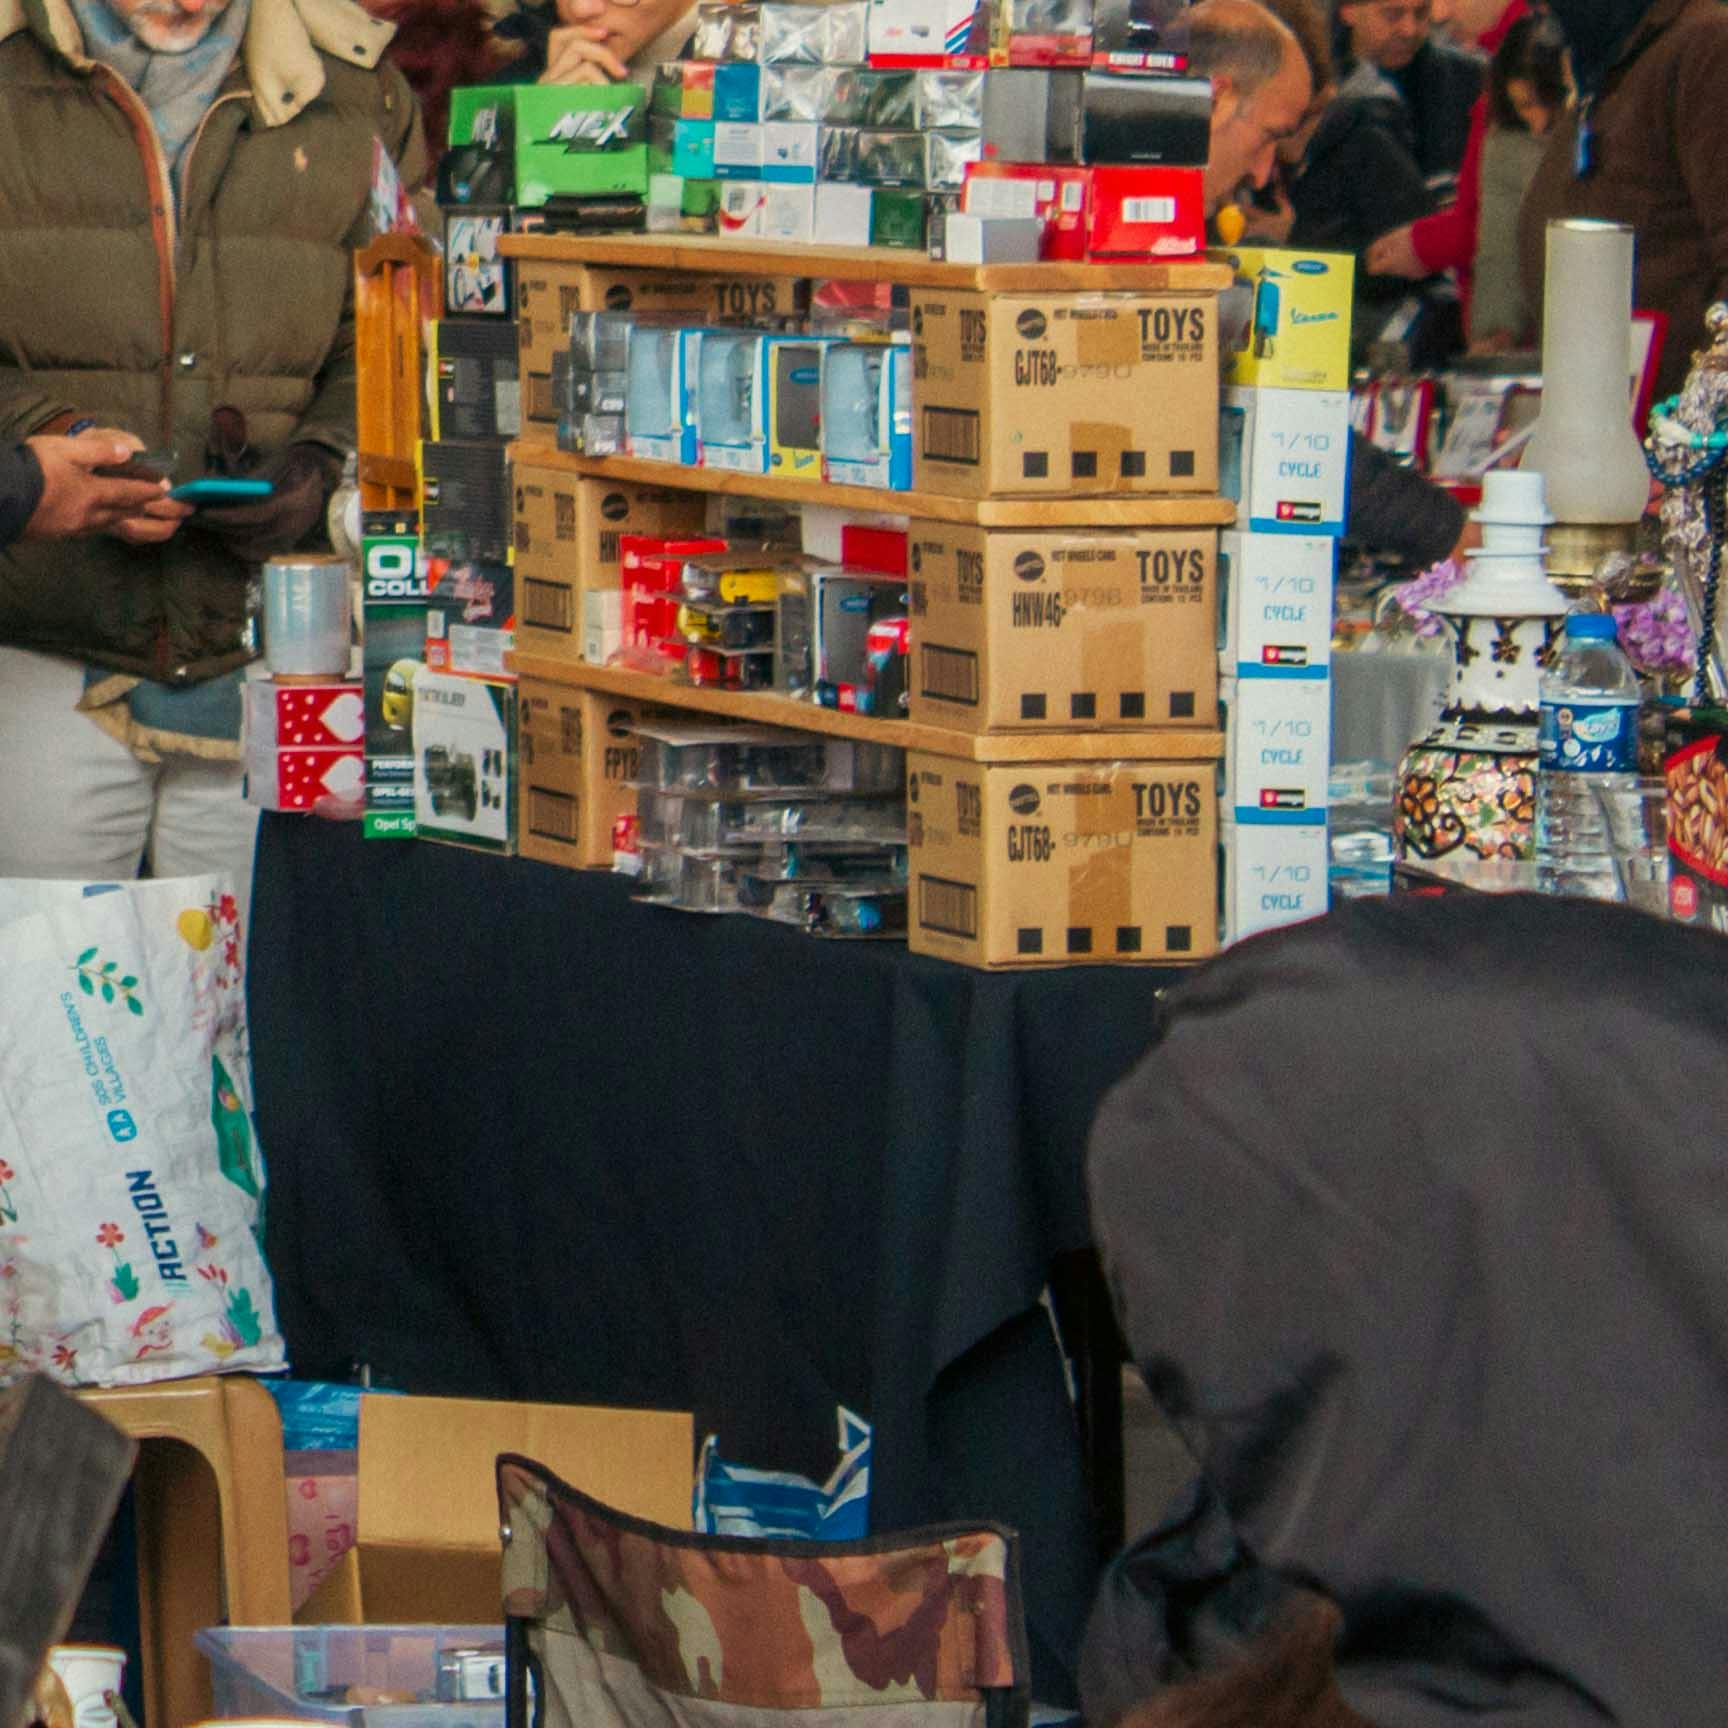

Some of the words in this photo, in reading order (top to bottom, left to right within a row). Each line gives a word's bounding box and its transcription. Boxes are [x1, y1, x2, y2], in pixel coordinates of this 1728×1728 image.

[713, 280, 777, 315] TOYS
[1138, 307, 1204, 341] TOYS
[1279, 462, 1321, 479] CYCLE
[1136, 550, 1204, 583] TOYS
[1263, 605, 1307, 622] CYCLE
[1260, 749, 1304, 766] CYCLE
[1132, 782, 1201, 817] TOYS
[373, 818, 400, 833] Opel
[1260, 894, 1304, 910] CYCLE
[59, 991, 99, 1077] CHILDREN'S
[94, 1036, 127, 1102] VILLAGES
[92, 1080, 111, 1106] SOS
[125, 1169, 188, 1282] ACTION
